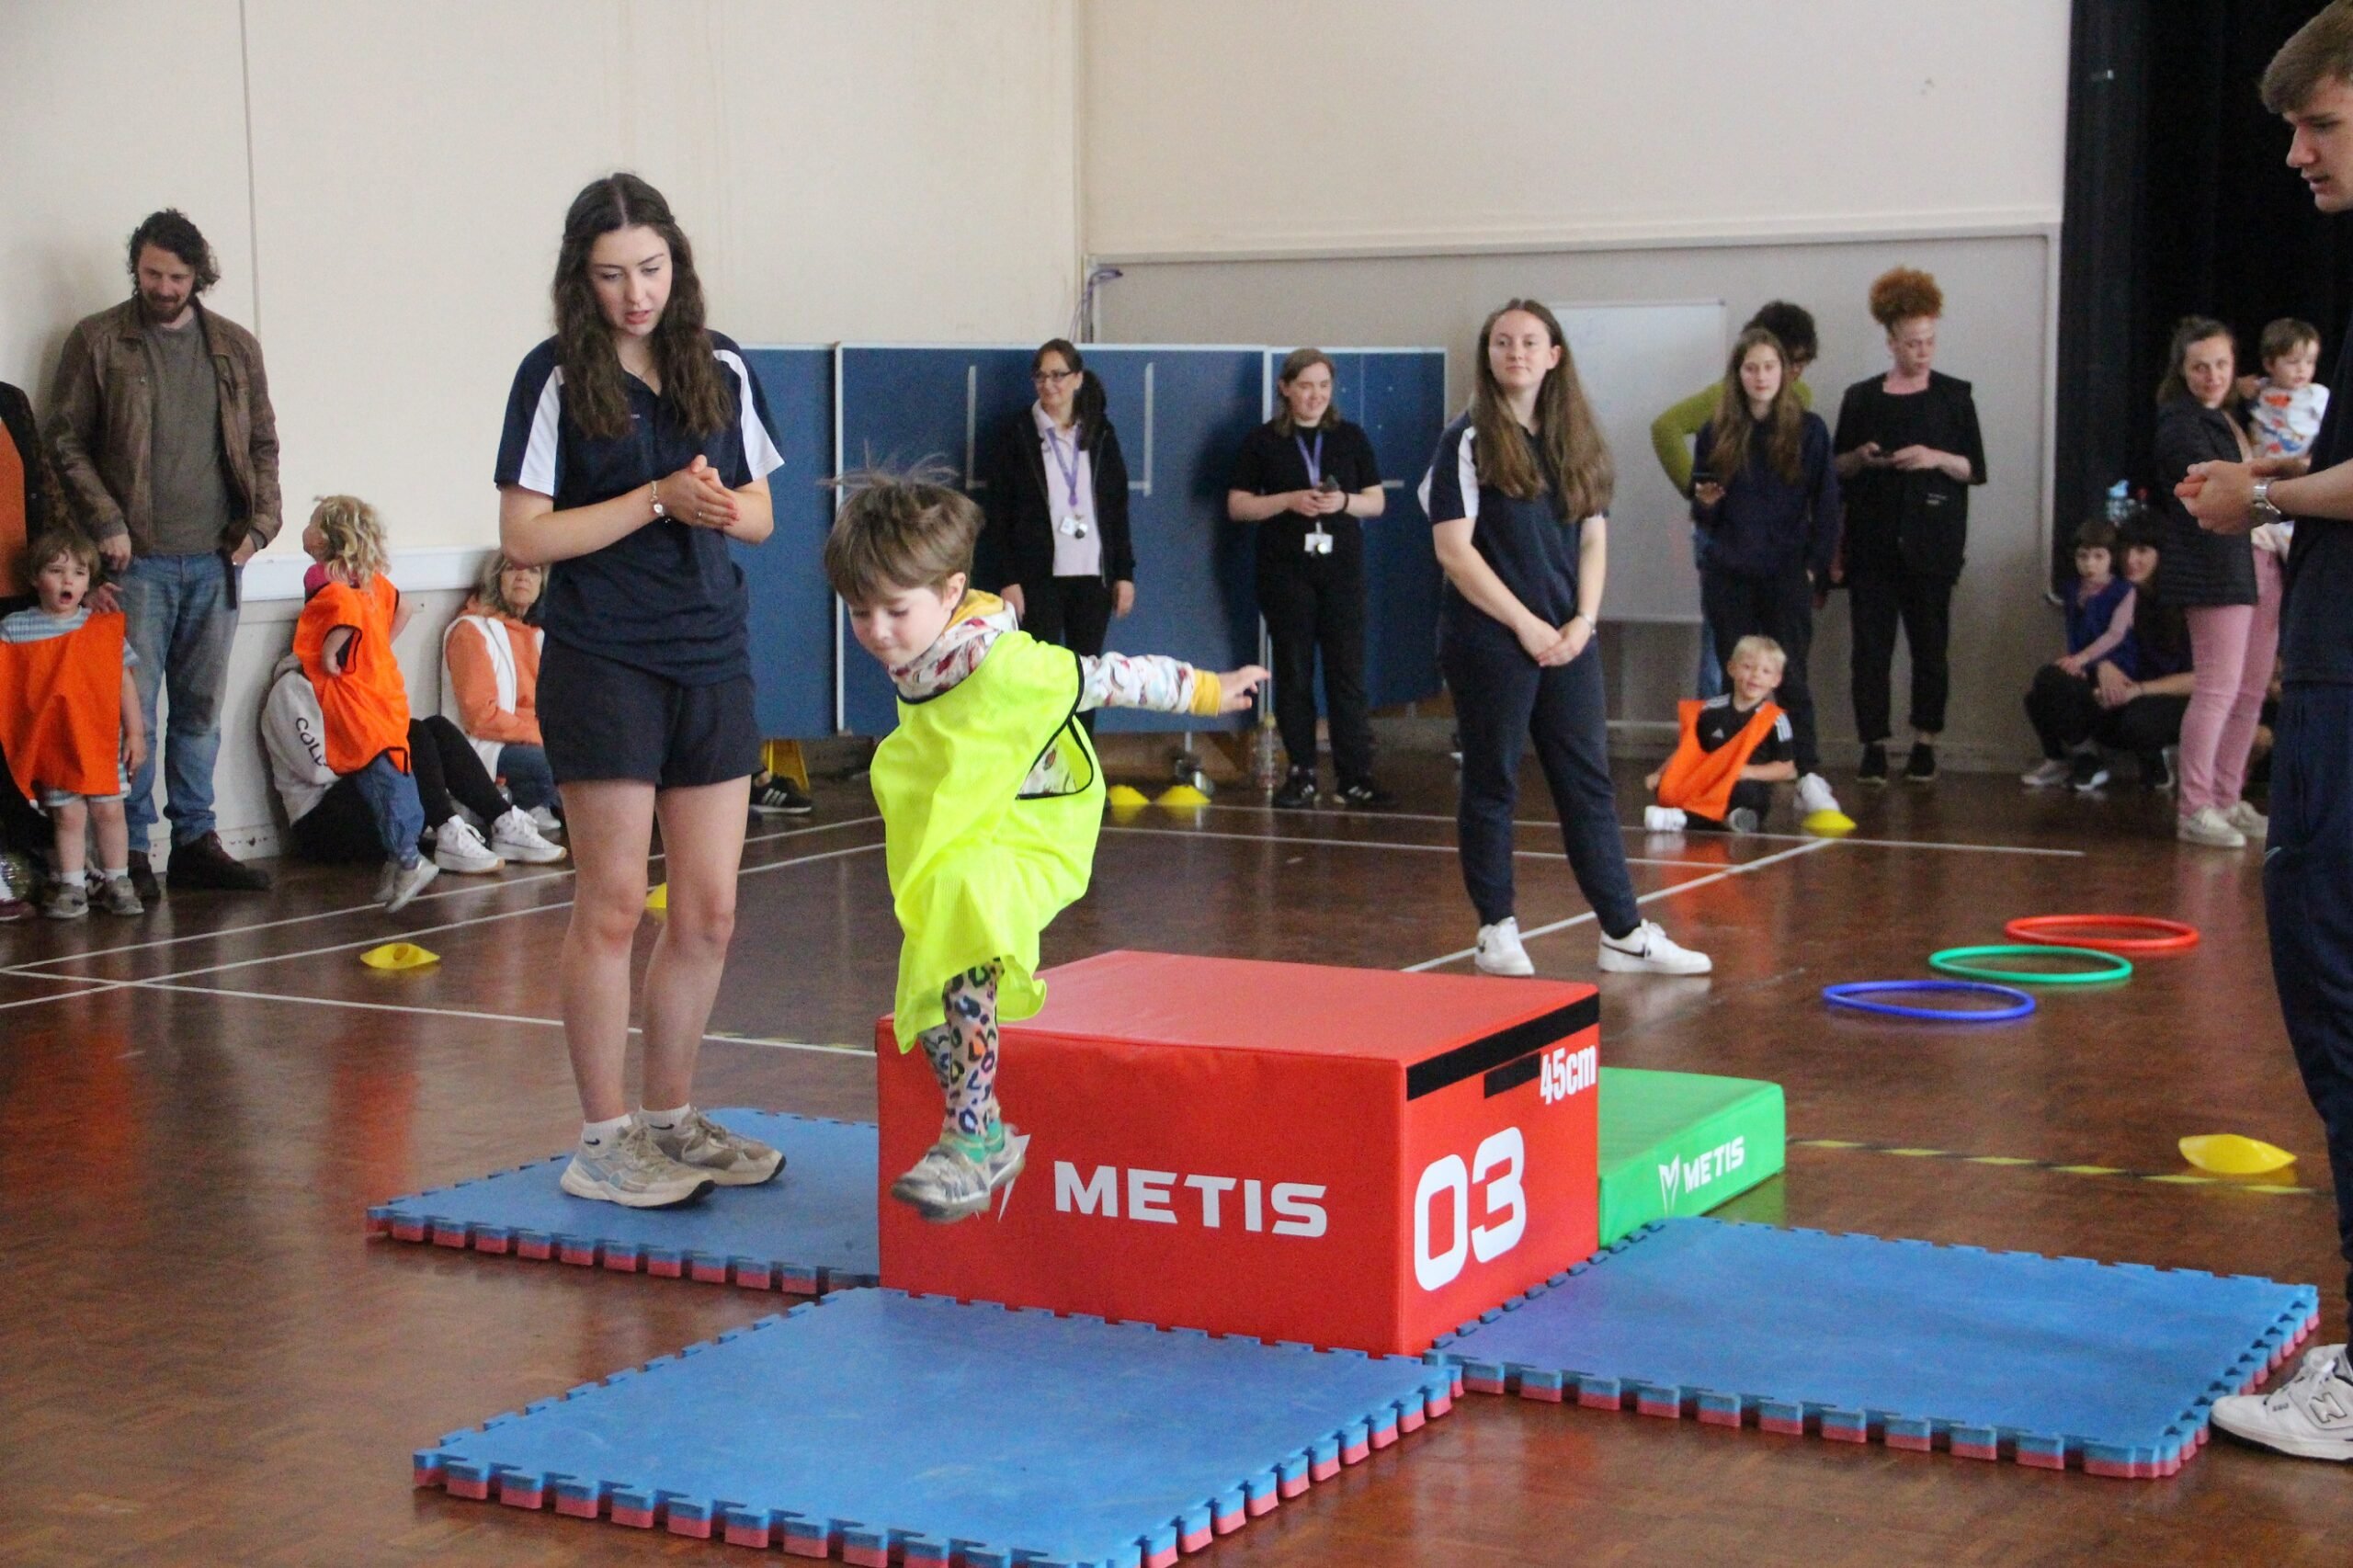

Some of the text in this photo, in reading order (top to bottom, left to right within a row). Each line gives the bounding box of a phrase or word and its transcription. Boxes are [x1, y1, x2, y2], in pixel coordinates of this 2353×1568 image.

[1540, 1045, 1597, 1105] 45cm
[1683, 1135, 1745, 1194] METIS
[1054, 1161, 1327, 1237] METIS
[1414, 1126, 1527, 1291] 03
